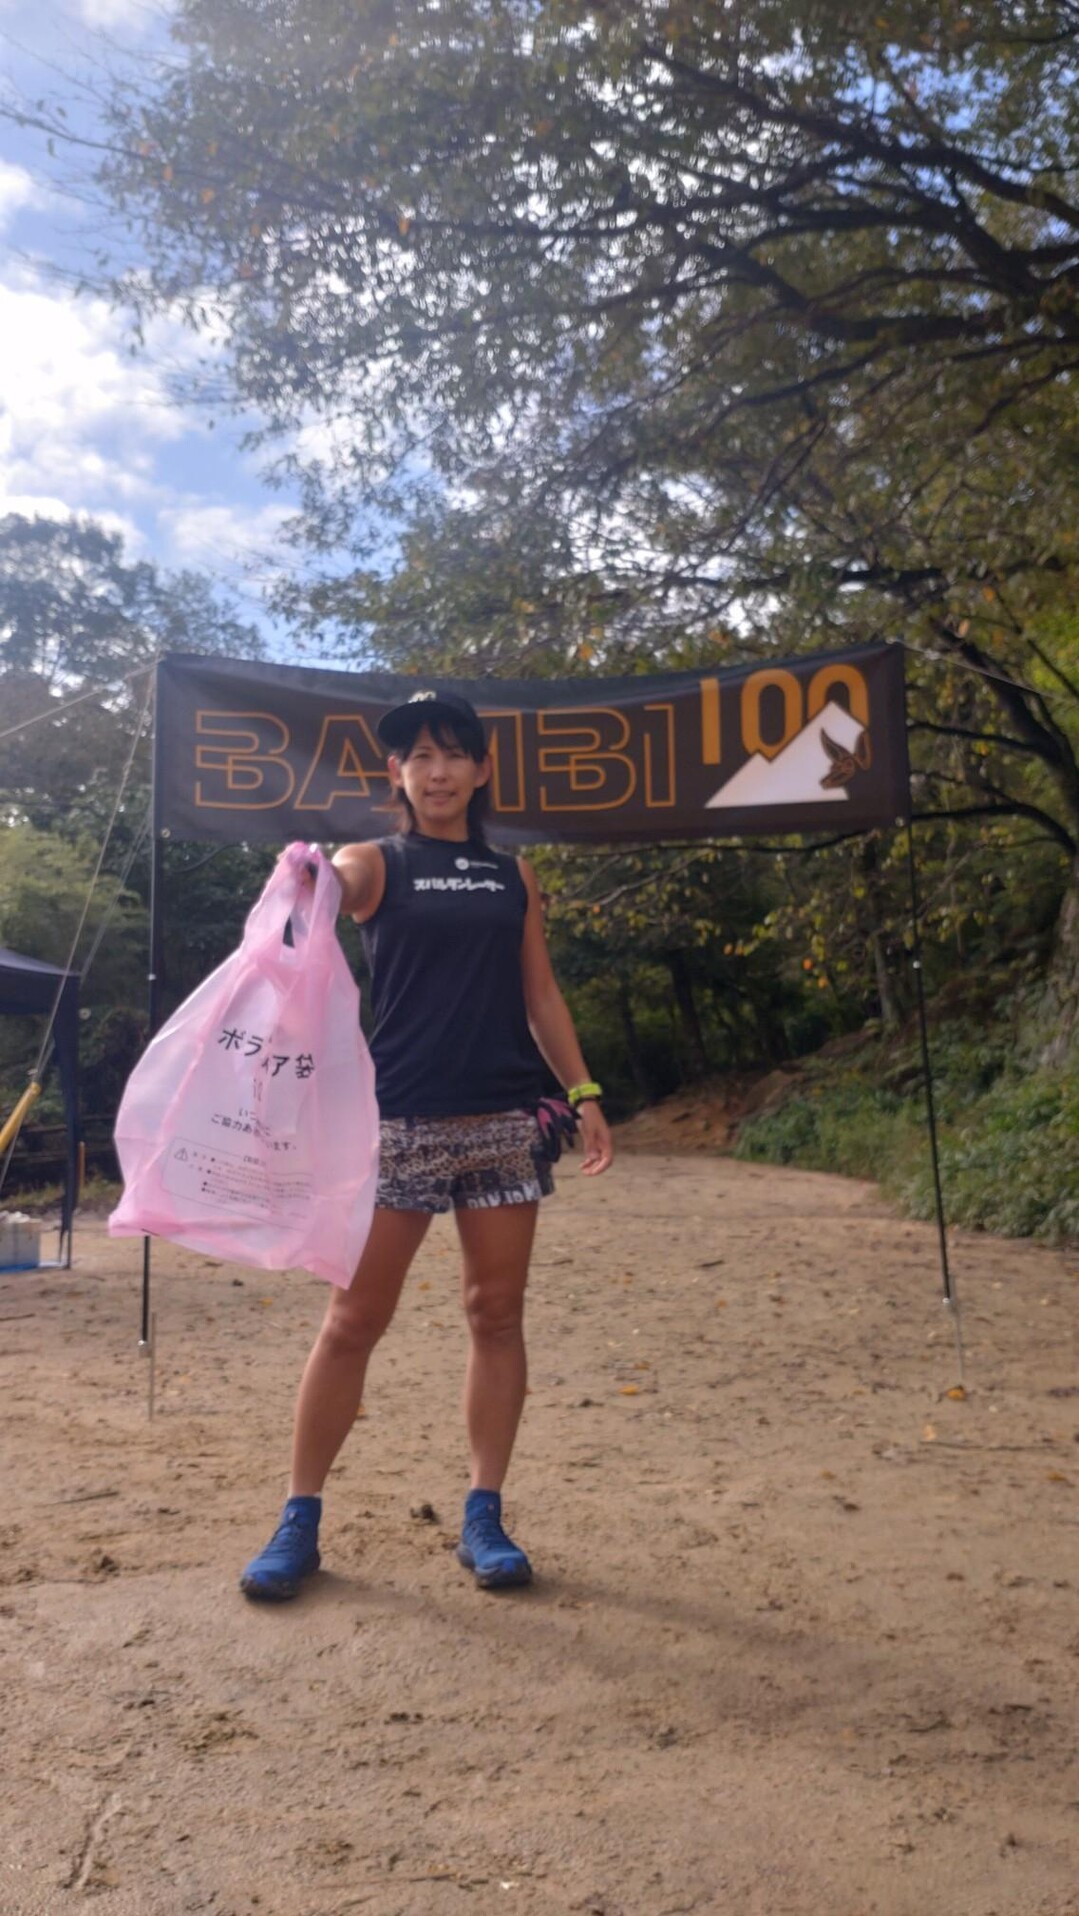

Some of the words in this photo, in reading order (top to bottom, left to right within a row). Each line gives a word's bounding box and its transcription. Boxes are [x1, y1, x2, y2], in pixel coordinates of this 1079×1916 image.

[217, 1028, 316, 1080] ボラィア袋
